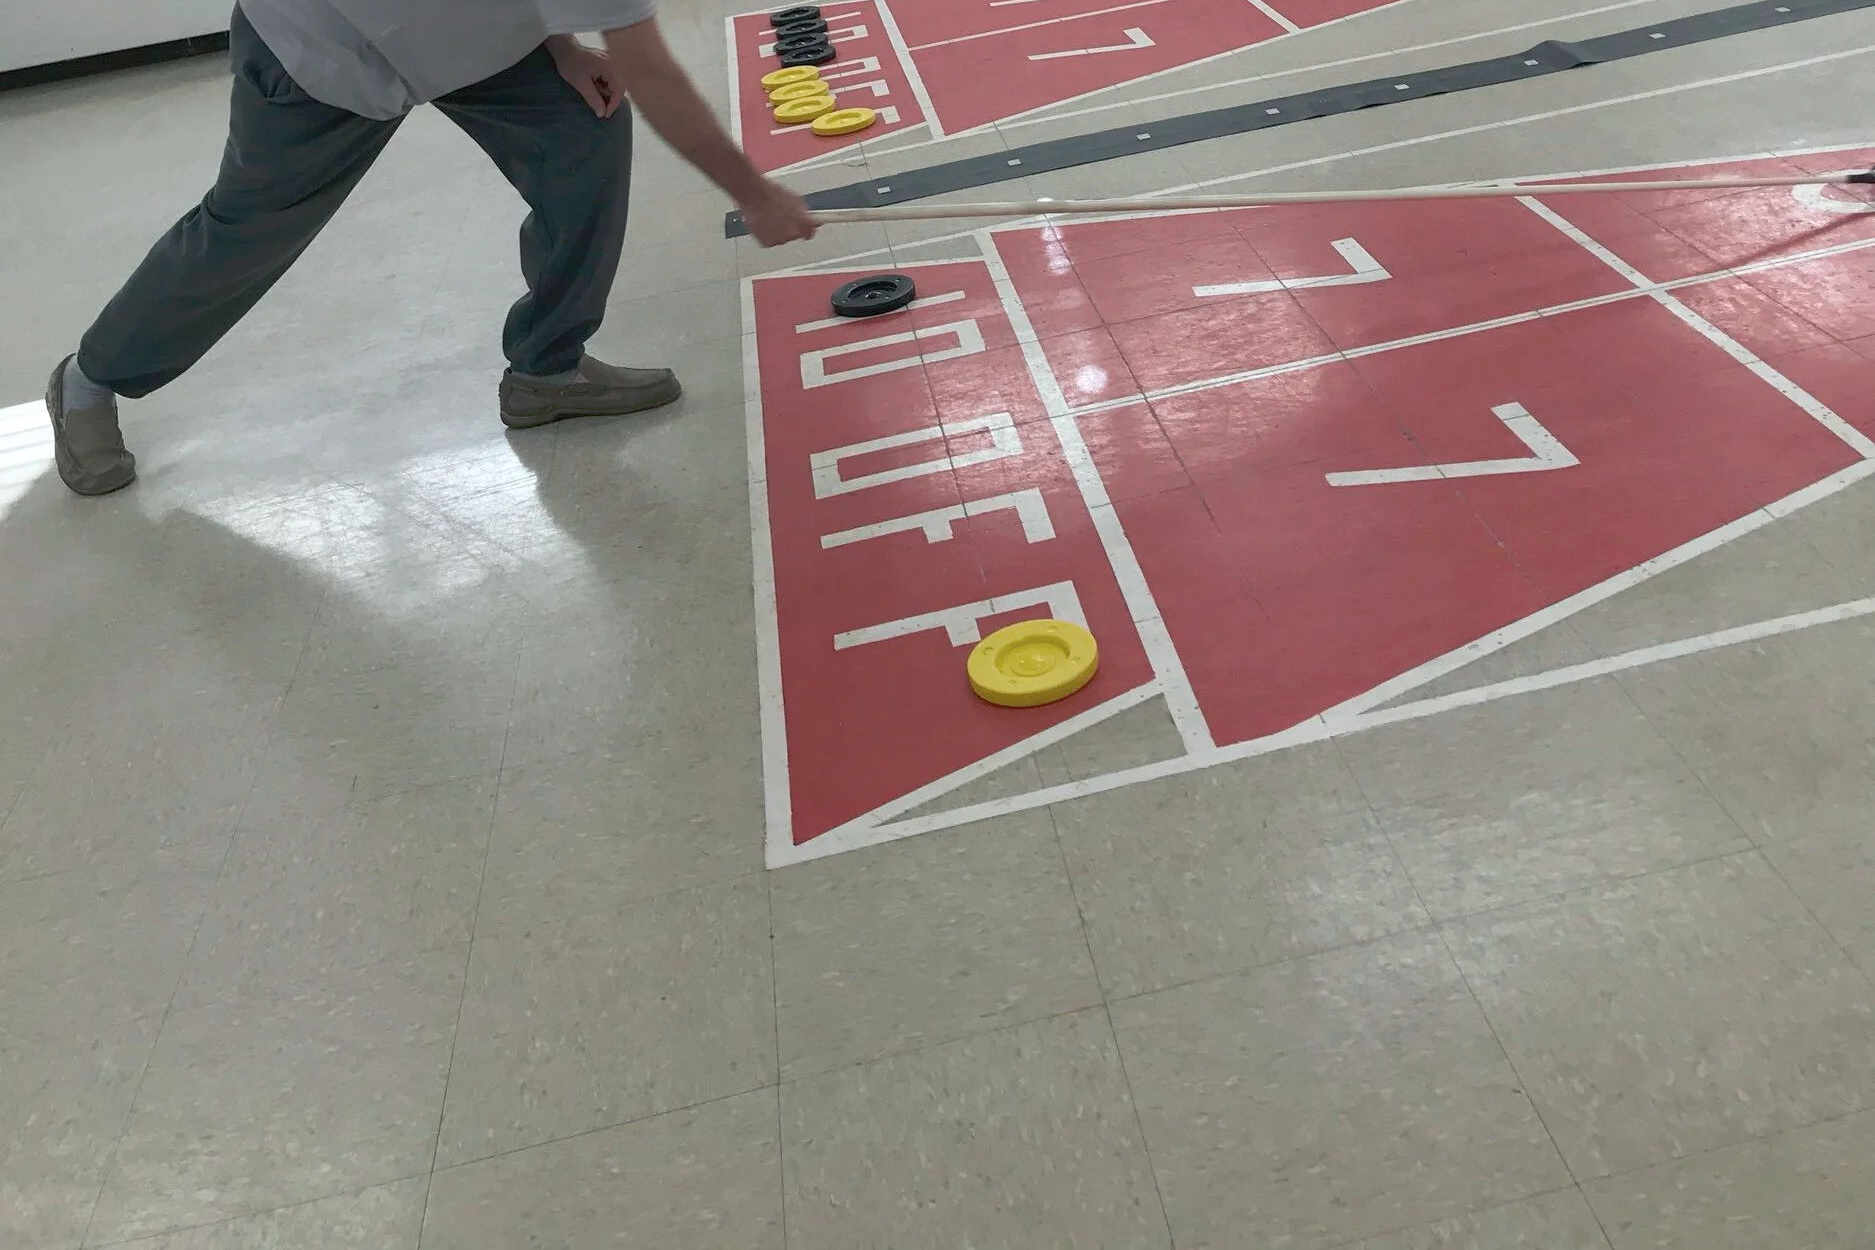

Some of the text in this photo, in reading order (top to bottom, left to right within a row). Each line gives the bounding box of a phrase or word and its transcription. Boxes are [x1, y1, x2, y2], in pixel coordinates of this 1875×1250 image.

[1027, 27, 1156, 60] 7
[1192, 237, 1392, 297] 7
[796, 291, 1092, 651] 10 OFF
[1325, 402, 1581, 486] 7
